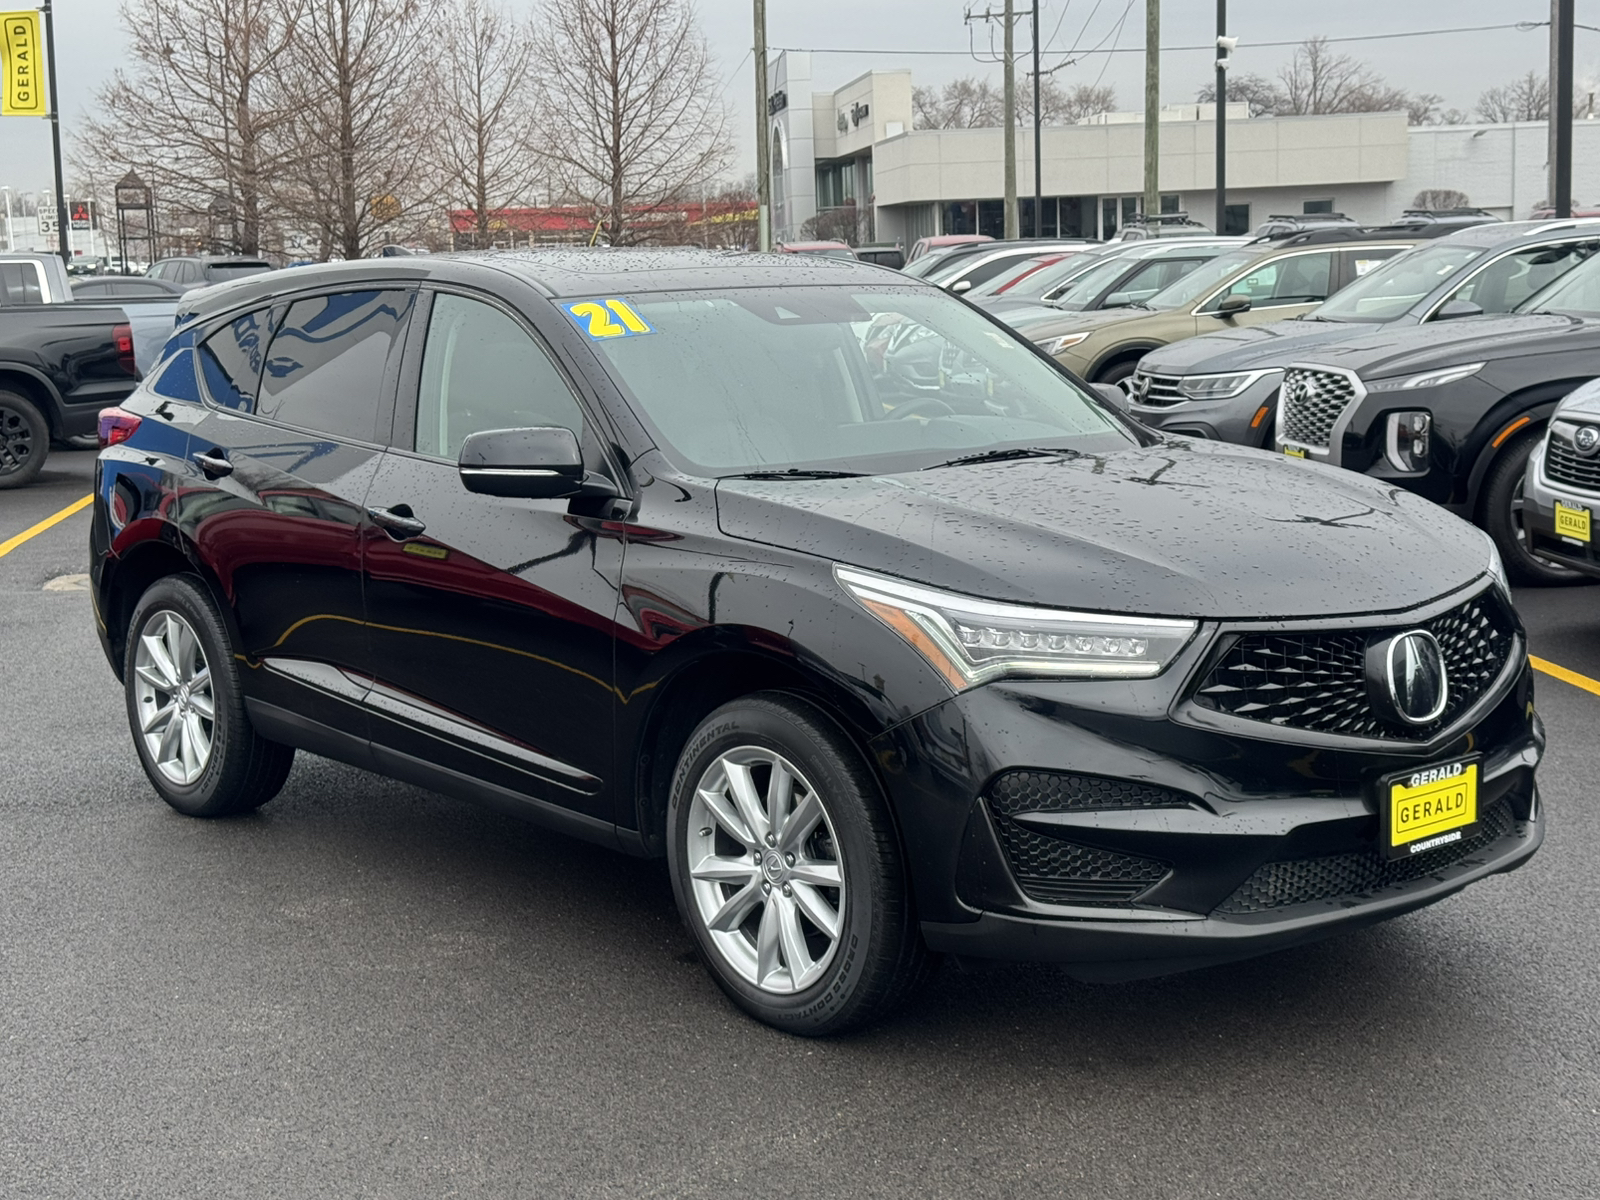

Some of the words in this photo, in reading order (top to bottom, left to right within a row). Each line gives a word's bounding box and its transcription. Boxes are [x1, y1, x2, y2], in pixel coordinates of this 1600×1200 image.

[13, 25, 30, 102] GERALD
[41, 221, 60, 233] 35
[569, 299, 651, 338] 21
[1560, 514, 1586, 530] GERALD
[671, 721, 740, 811] CONTINENTAL
[1410, 762, 1462, 788] GERALD
[1400, 792, 1464, 824] GERALD
[1410, 830, 1462, 854] COUNTRYSIDE
